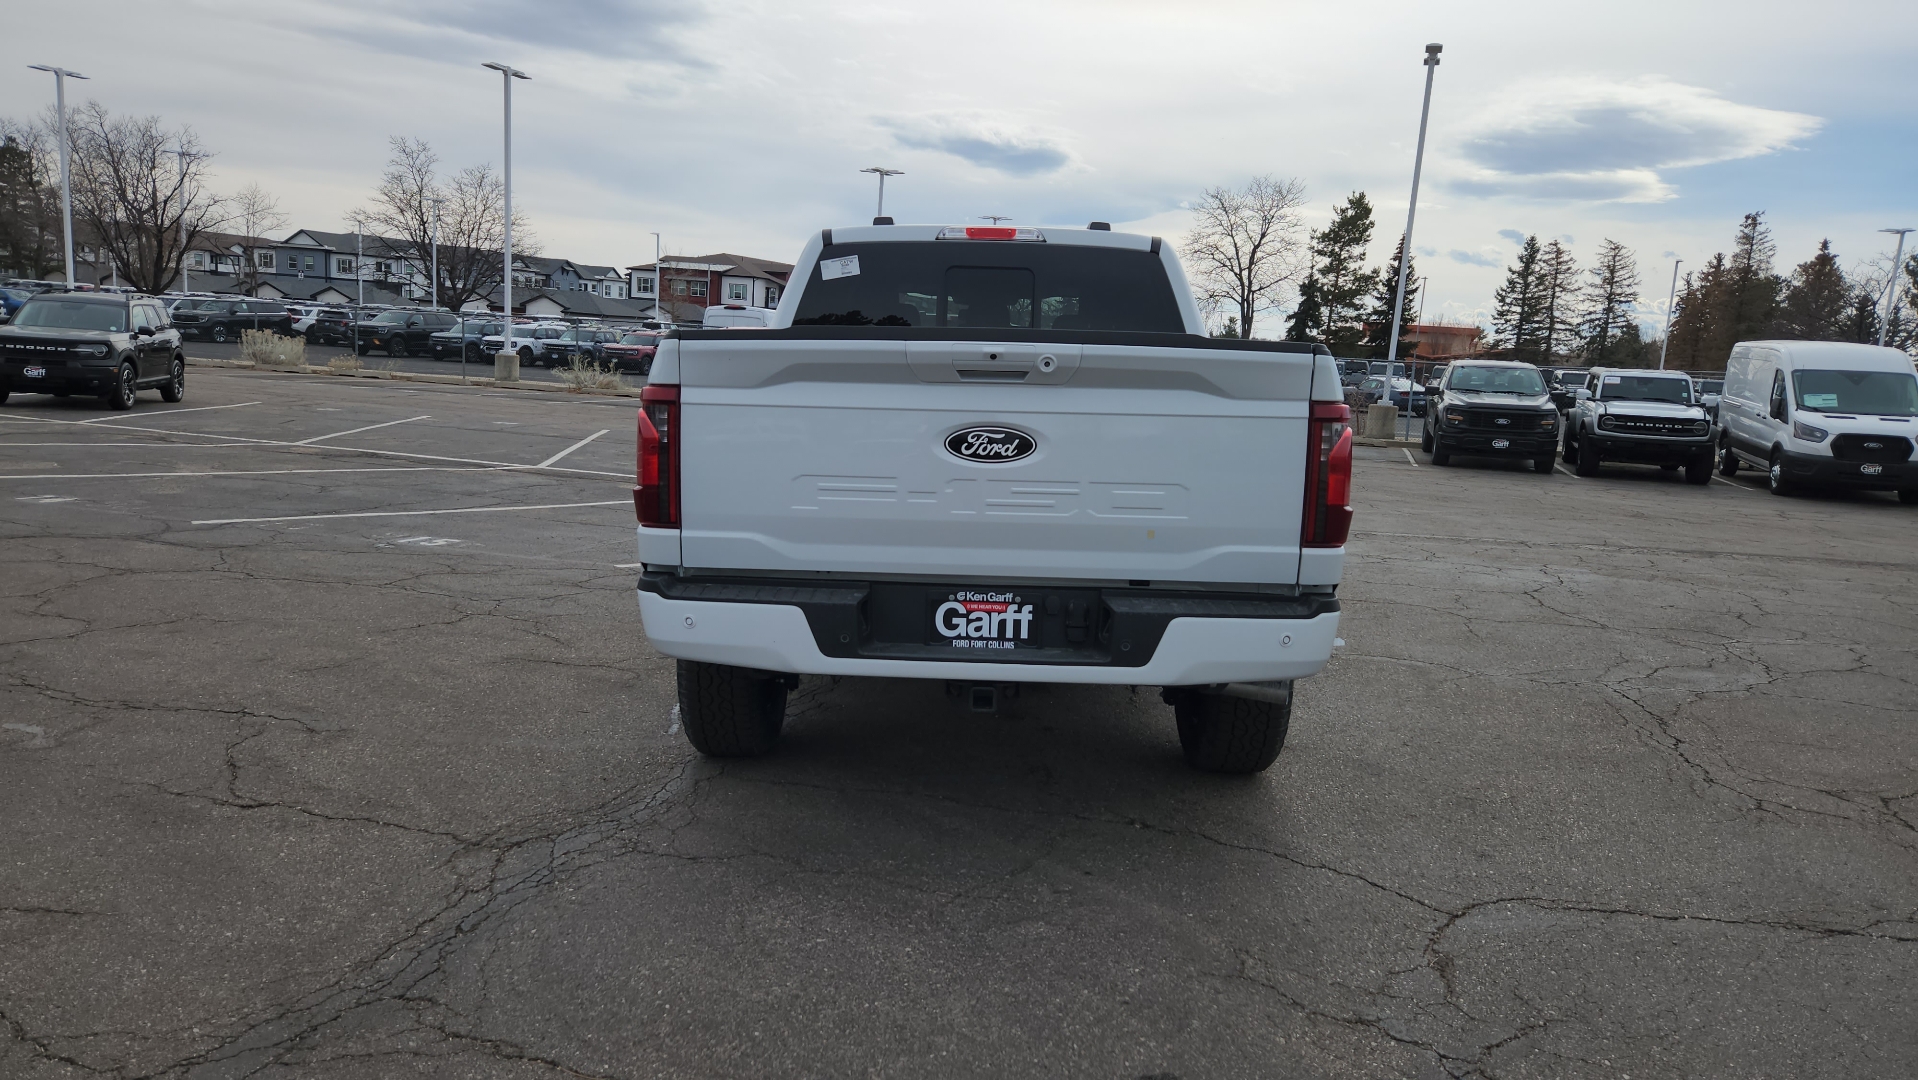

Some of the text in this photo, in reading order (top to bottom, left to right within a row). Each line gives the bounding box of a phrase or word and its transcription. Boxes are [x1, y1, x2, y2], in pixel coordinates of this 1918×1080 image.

[23, 367, 46, 376] Garff
[961, 431, 1020, 457] Ford
[966, 591, 1014, 603] Ken Garff
[935, 601, 1034, 639] Garff
[952, 639, 1015, 650] FORD FORT COLLINS
